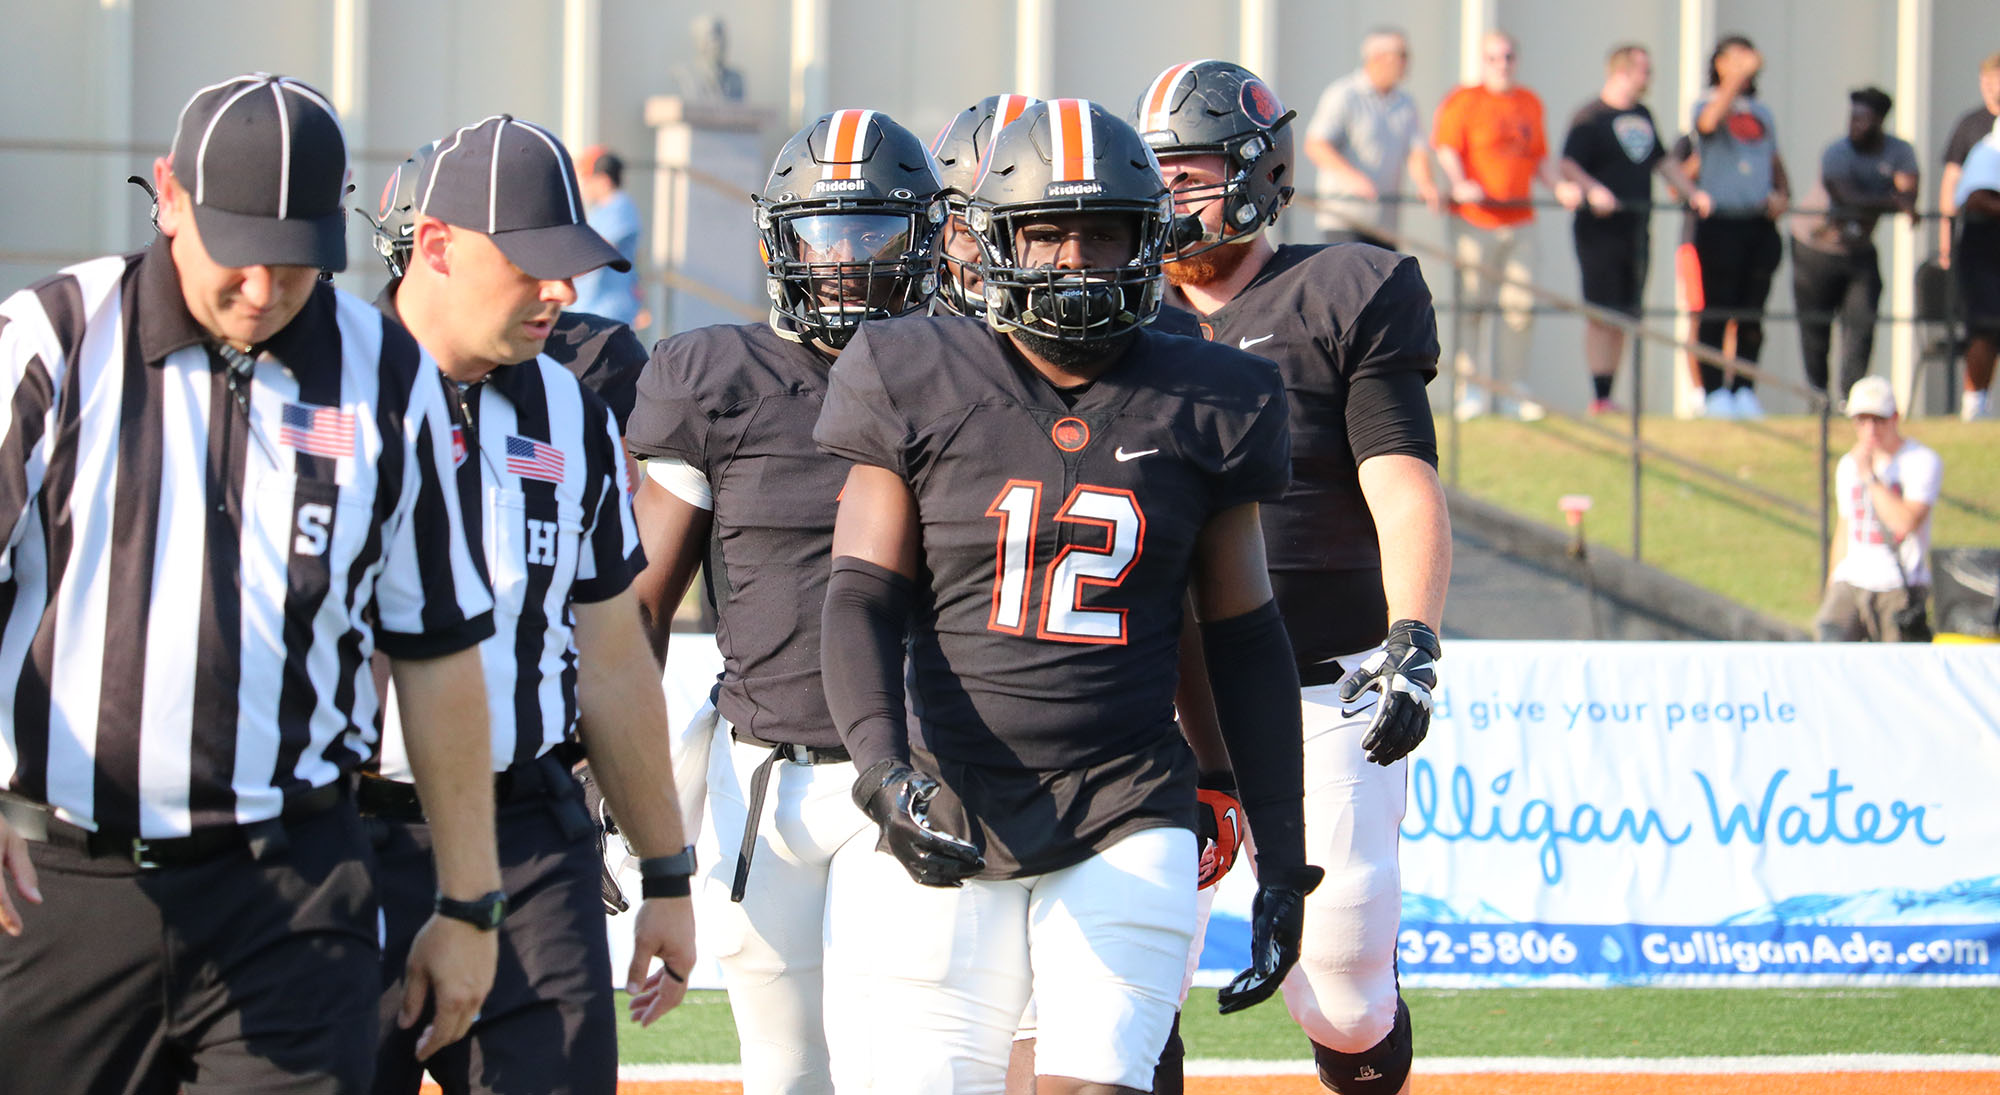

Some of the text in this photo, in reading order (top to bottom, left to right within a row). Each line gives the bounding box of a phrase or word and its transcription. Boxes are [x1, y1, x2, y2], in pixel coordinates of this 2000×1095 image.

[815, 179, 865, 192] Riddell
[295, 503, 332, 556] S
[527, 519, 558, 566] H
[985, 479, 1146, 645] 12
[1432, 687, 1796, 732] d give your people
[1400, 758, 1945, 885] lligan Water
[1398, 929, 1989, 972] 32-5806 CulliganAda.com
